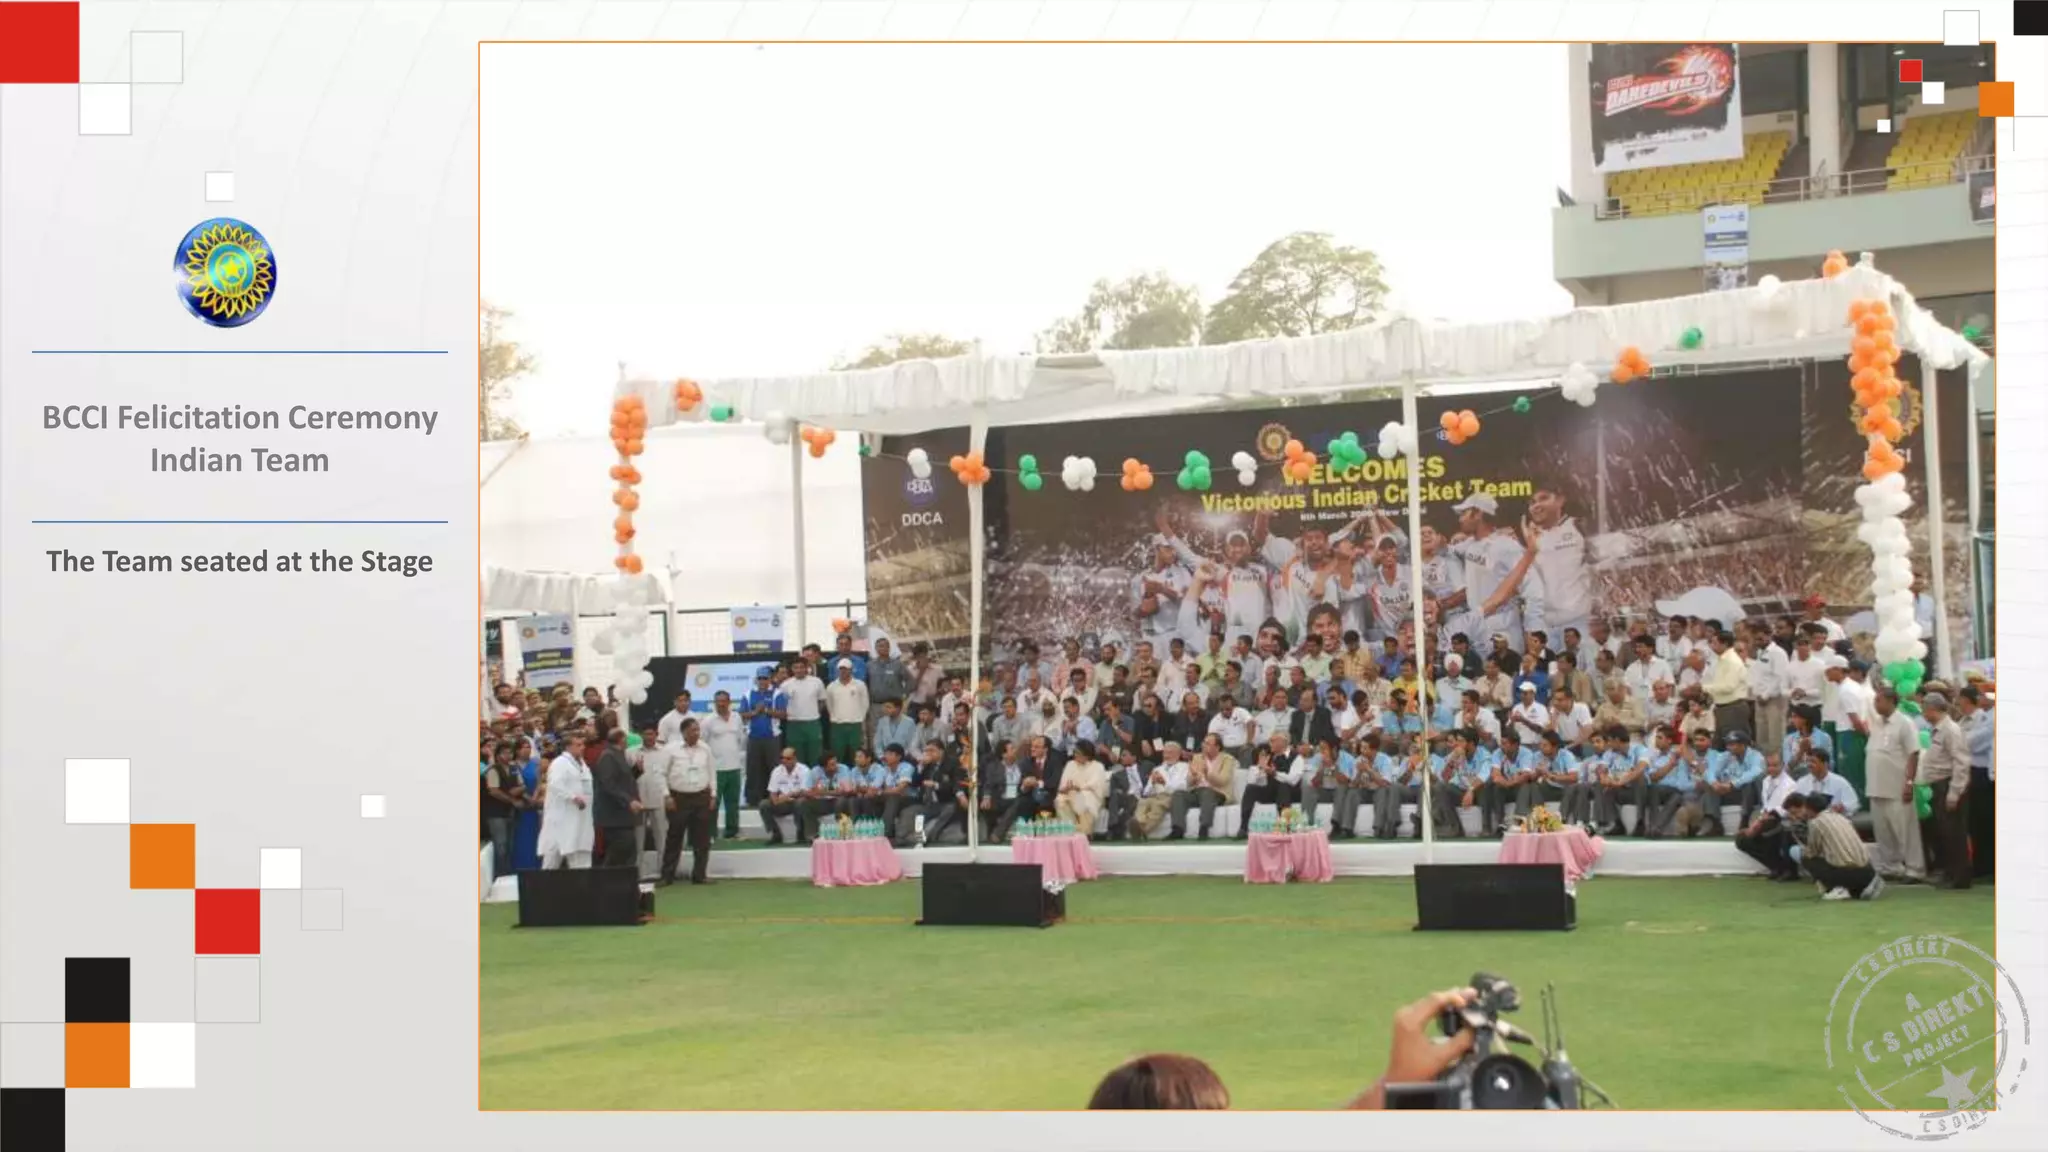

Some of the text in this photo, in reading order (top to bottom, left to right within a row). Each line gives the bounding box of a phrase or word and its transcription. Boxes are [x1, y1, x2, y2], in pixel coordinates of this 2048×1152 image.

[1201, 478, 1532, 514] Victorious Indian Crcket Team
[902, 512, 943, 526] DDCA
